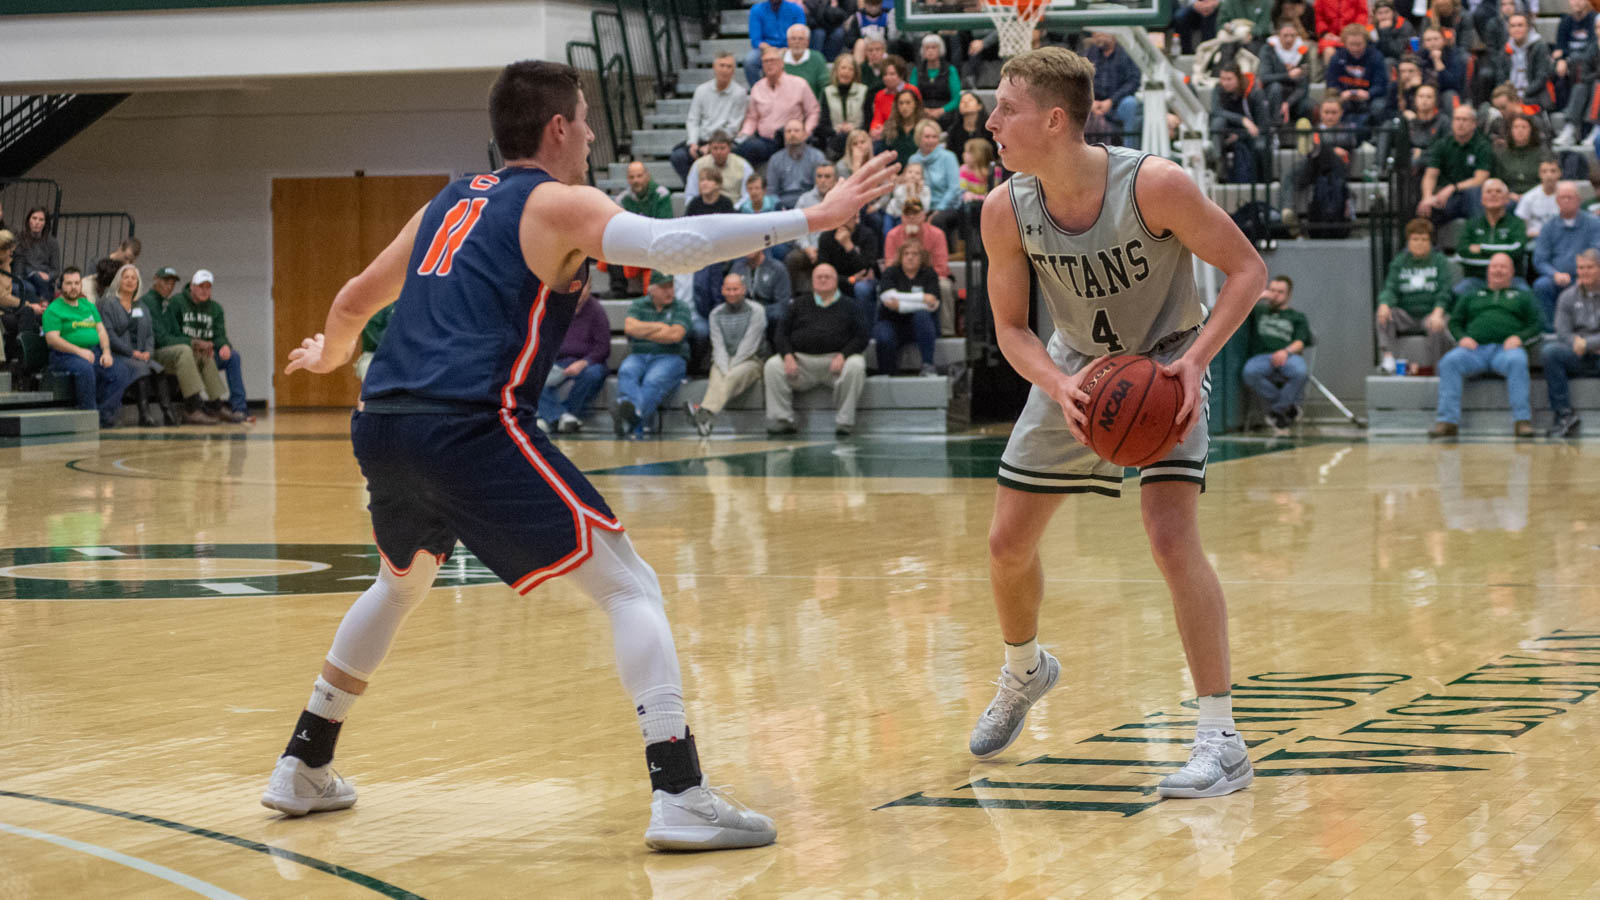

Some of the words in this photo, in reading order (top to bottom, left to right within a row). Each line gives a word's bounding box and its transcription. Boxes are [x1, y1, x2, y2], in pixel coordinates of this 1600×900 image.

[417, 197, 489, 276] 11
[1030, 239, 1150, 299] TITANS
[1091, 308, 1126, 353] 4
[1098, 379, 1134, 433] NCAA
